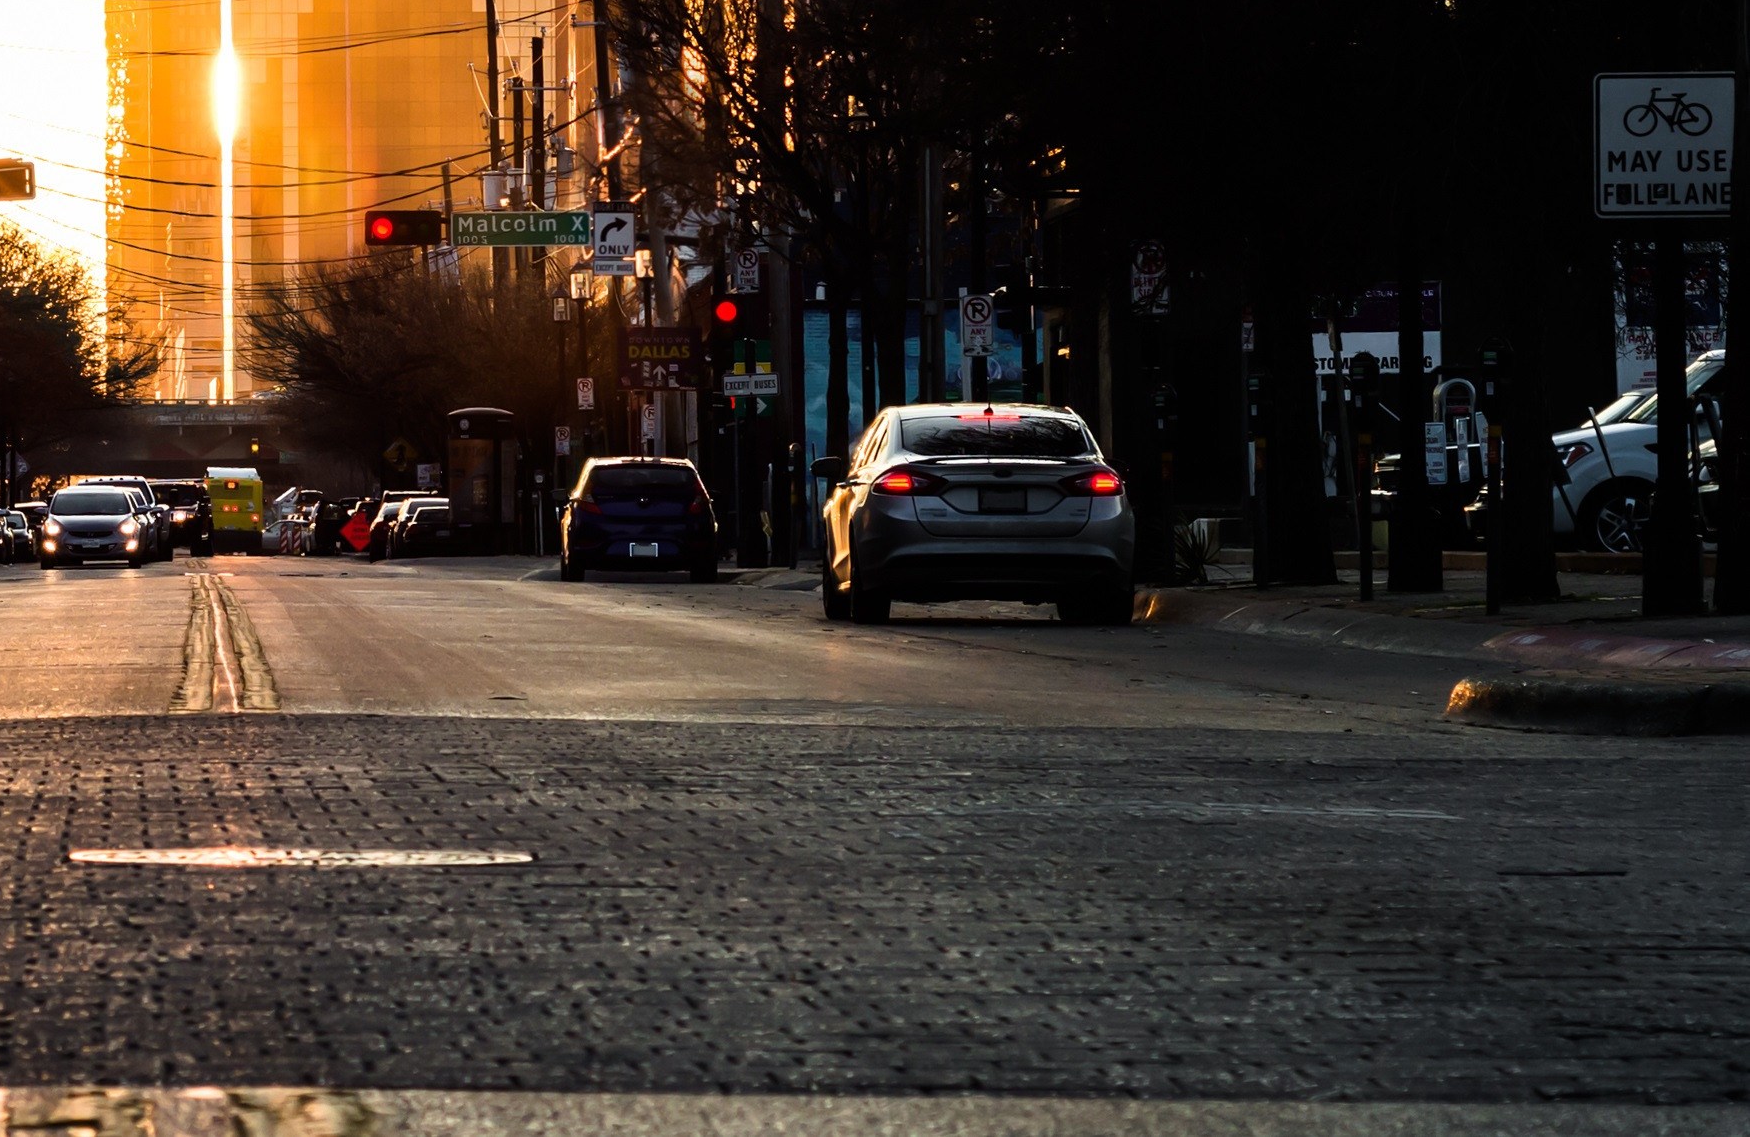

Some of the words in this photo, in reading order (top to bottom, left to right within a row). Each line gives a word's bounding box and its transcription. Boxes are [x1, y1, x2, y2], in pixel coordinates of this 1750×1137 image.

[1608, 150, 1662, 172] MAY
[1677, 150, 1727, 172] USE
[1604, 183, 1657, 205] FLL
[1671, 182, 1732, 205] LANE
[457, 215, 557, 233] Malcolm
[571, 215, 585, 232] X
[554, 234, 576, 244] 100
[578, 234, 586, 243] N
[599, 245, 630, 255] ONLY
[628, 336, 691, 344] DOWNTOWN
[628, 345, 691, 359] DALLAS
[725, 380, 749, 391] EXCEPT
[754, 379, 776, 390] BUSES
